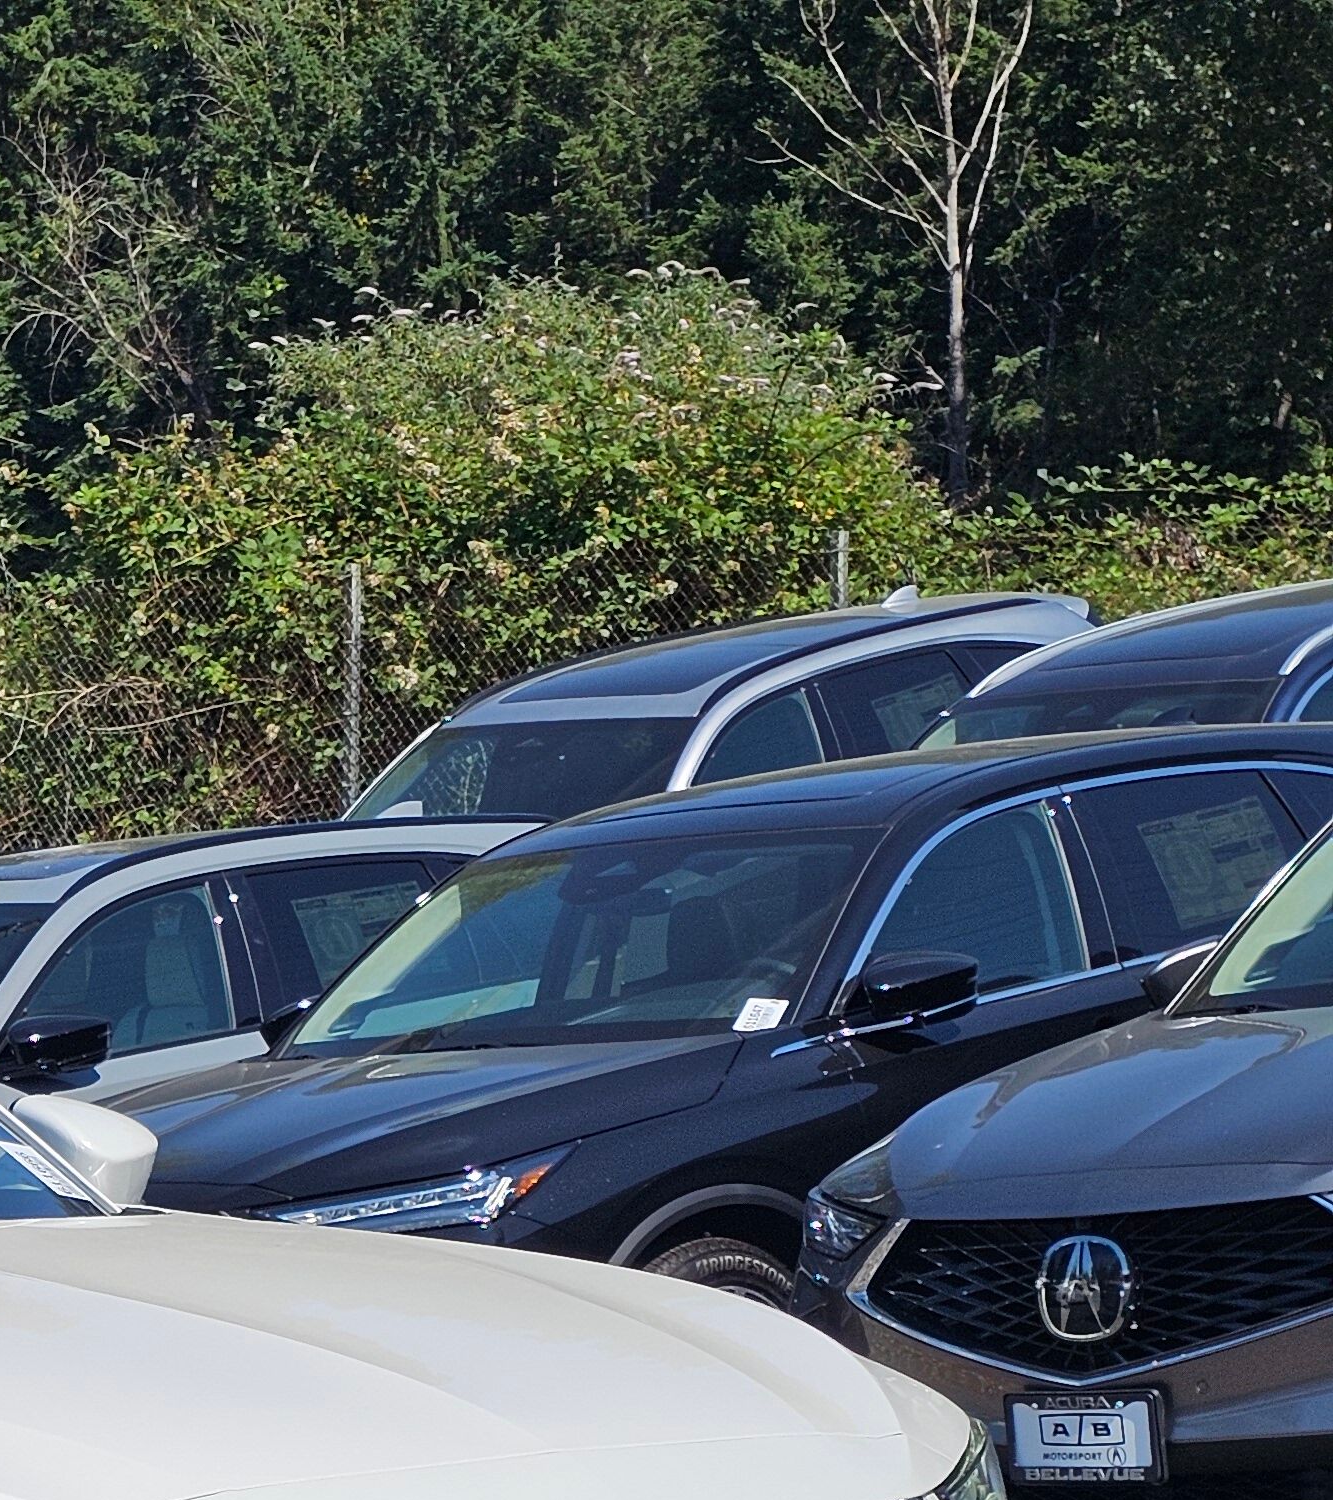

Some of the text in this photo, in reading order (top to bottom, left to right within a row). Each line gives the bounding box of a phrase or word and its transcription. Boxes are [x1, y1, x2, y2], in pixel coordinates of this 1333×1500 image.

[1045, 1395, 1111, 1410] ACURA
[1042, 1452, 1102, 1461] MOTORSPORT
[1025, 1468, 1145, 1482] BELLEVUE
